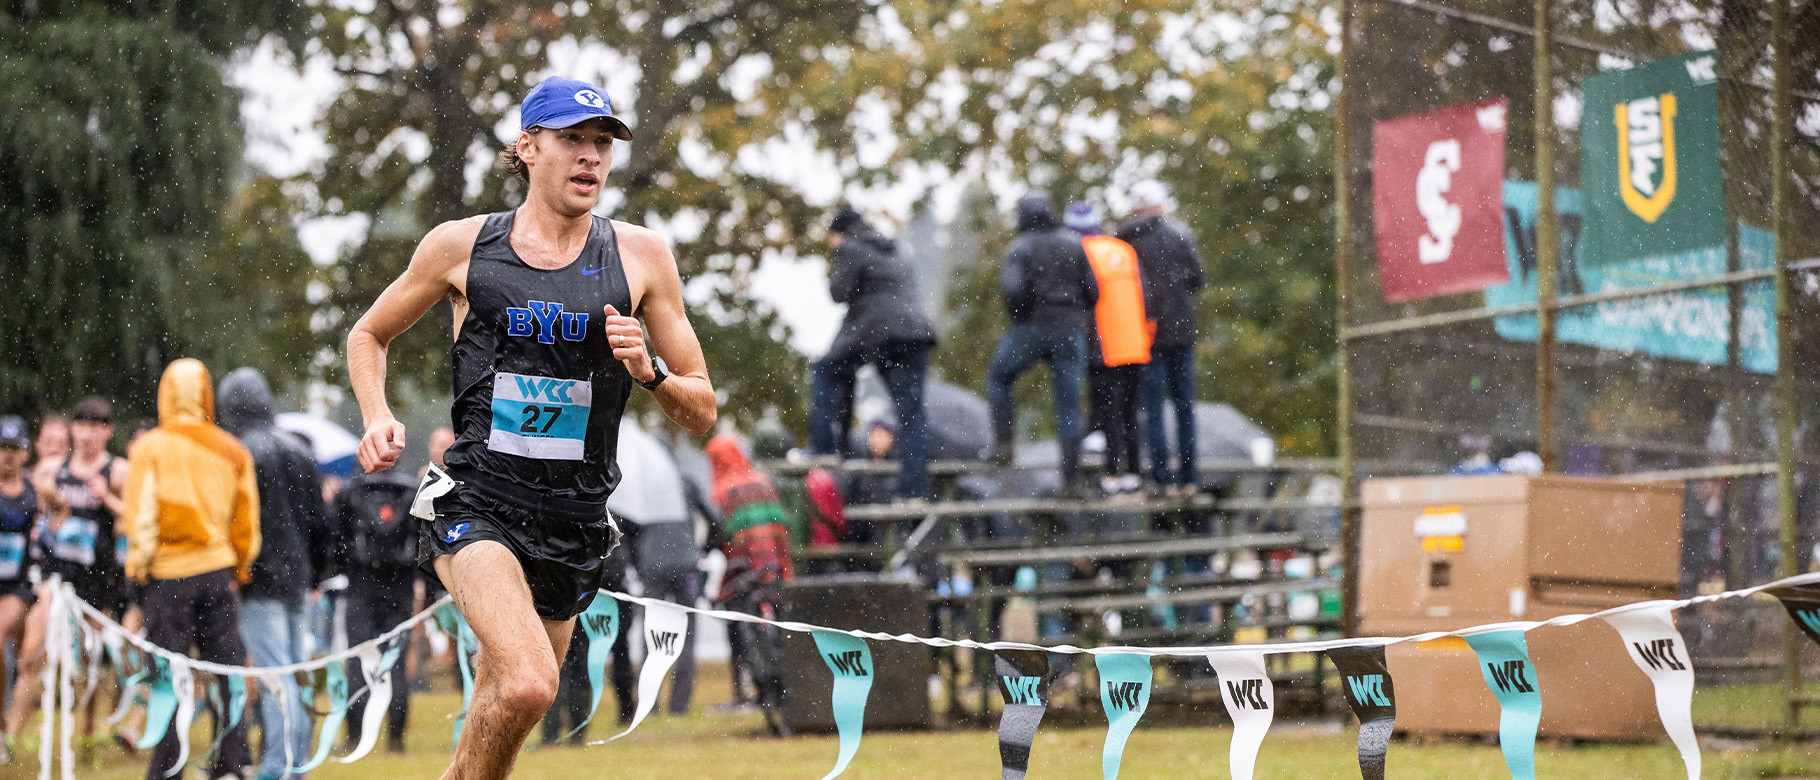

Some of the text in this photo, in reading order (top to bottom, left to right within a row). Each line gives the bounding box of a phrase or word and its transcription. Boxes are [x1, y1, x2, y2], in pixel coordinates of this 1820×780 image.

[507, 300, 589, 344] BYU
[513, 375, 577, 403] WCC
[520, 405, 562, 433] 27
[650, 630, 678, 656] WCC
[1633, 638, 1686, 671] WCC
[828, 650, 867, 677] WCC
[1488, 660, 1534, 693] WCC
[1003, 676, 1041, 706] WCC
[1107, 680, 1142, 713] WCC
[1226, 679, 1269, 710] WCC
[1346, 674, 1391, 707] WCC
